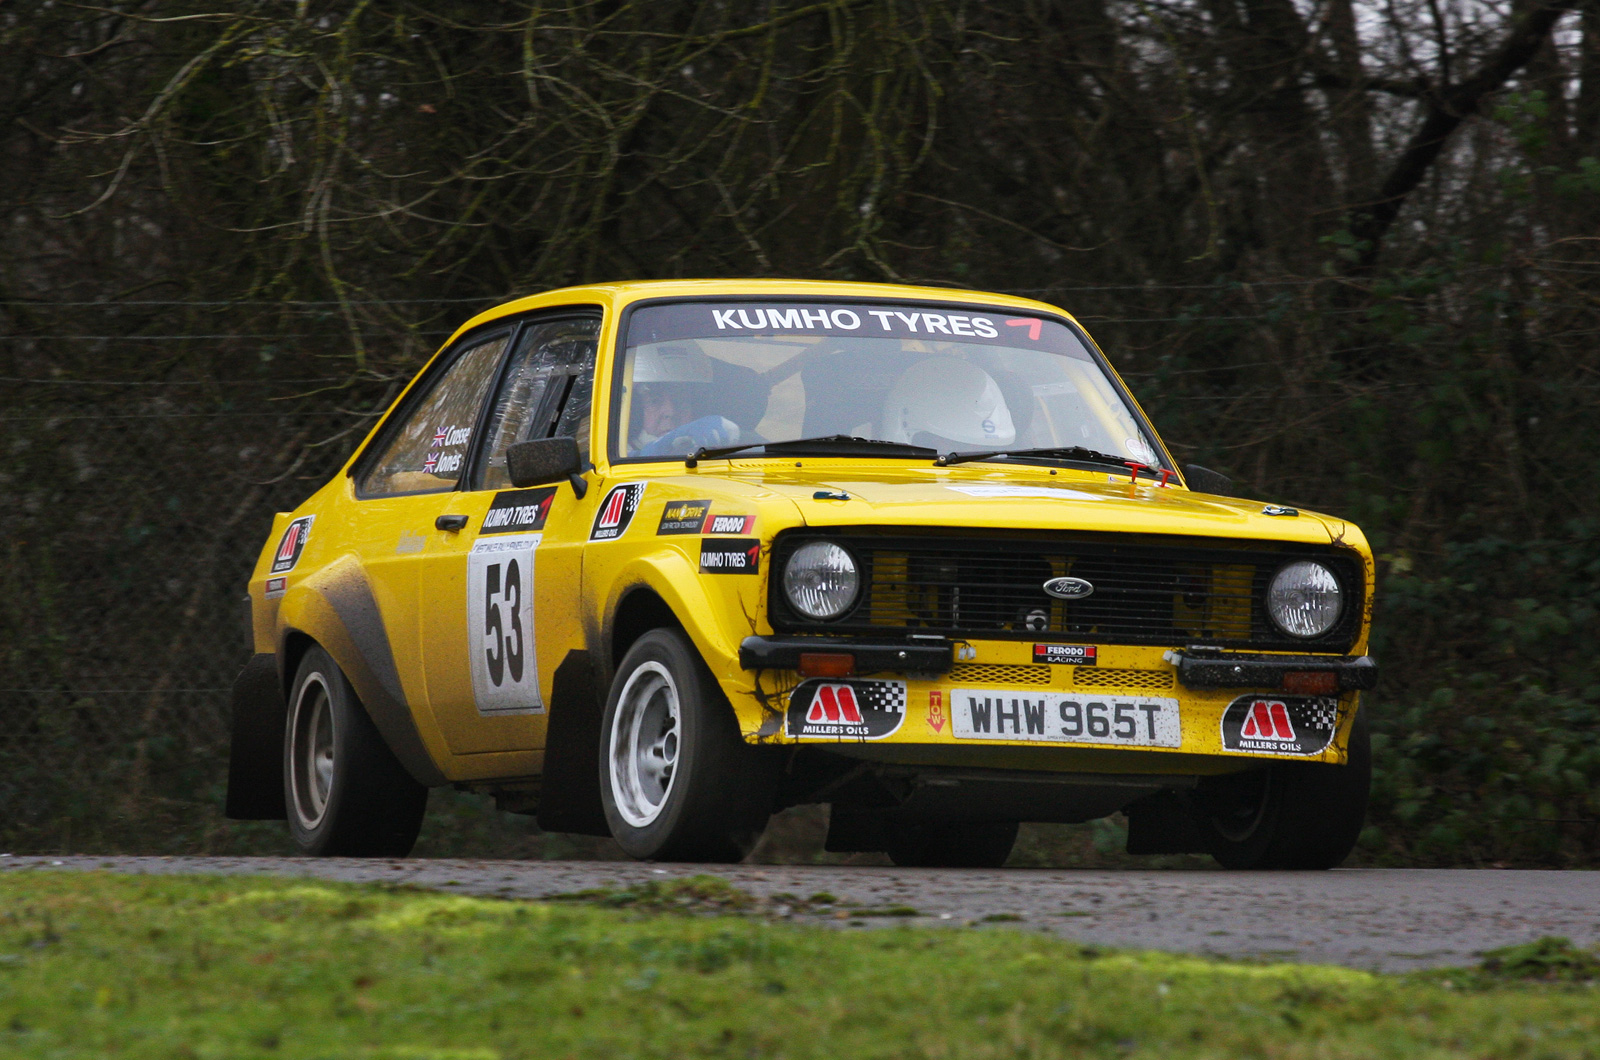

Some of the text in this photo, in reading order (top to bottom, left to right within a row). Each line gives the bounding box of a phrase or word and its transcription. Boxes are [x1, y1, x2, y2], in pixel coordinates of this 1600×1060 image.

[712, 308, 999, 339] KUMHO TYRES
[444, 425, 471, 447] Crosse
[434, 451, 463, 473] Jones
[482, 505, 539, 528] KUMHO TYRES
[711, 517, 745, 532] FERODO
[700, 552, 746, 568] KUMHO TYRES
[1055, 581, 1081, 593] Ford
[485, 558, 524, 687] 53
[1047, 646, 1084, 655] FERODO
[1047, 656, 1083, 664] RACING
[930, 694, 942, 726] TOW
[968, 696, 1161, 740] WHW 965T
[802, 725, 869, 735] MILLERS OILS
[1239, 740, 1302, 751] MILLERS OILS
